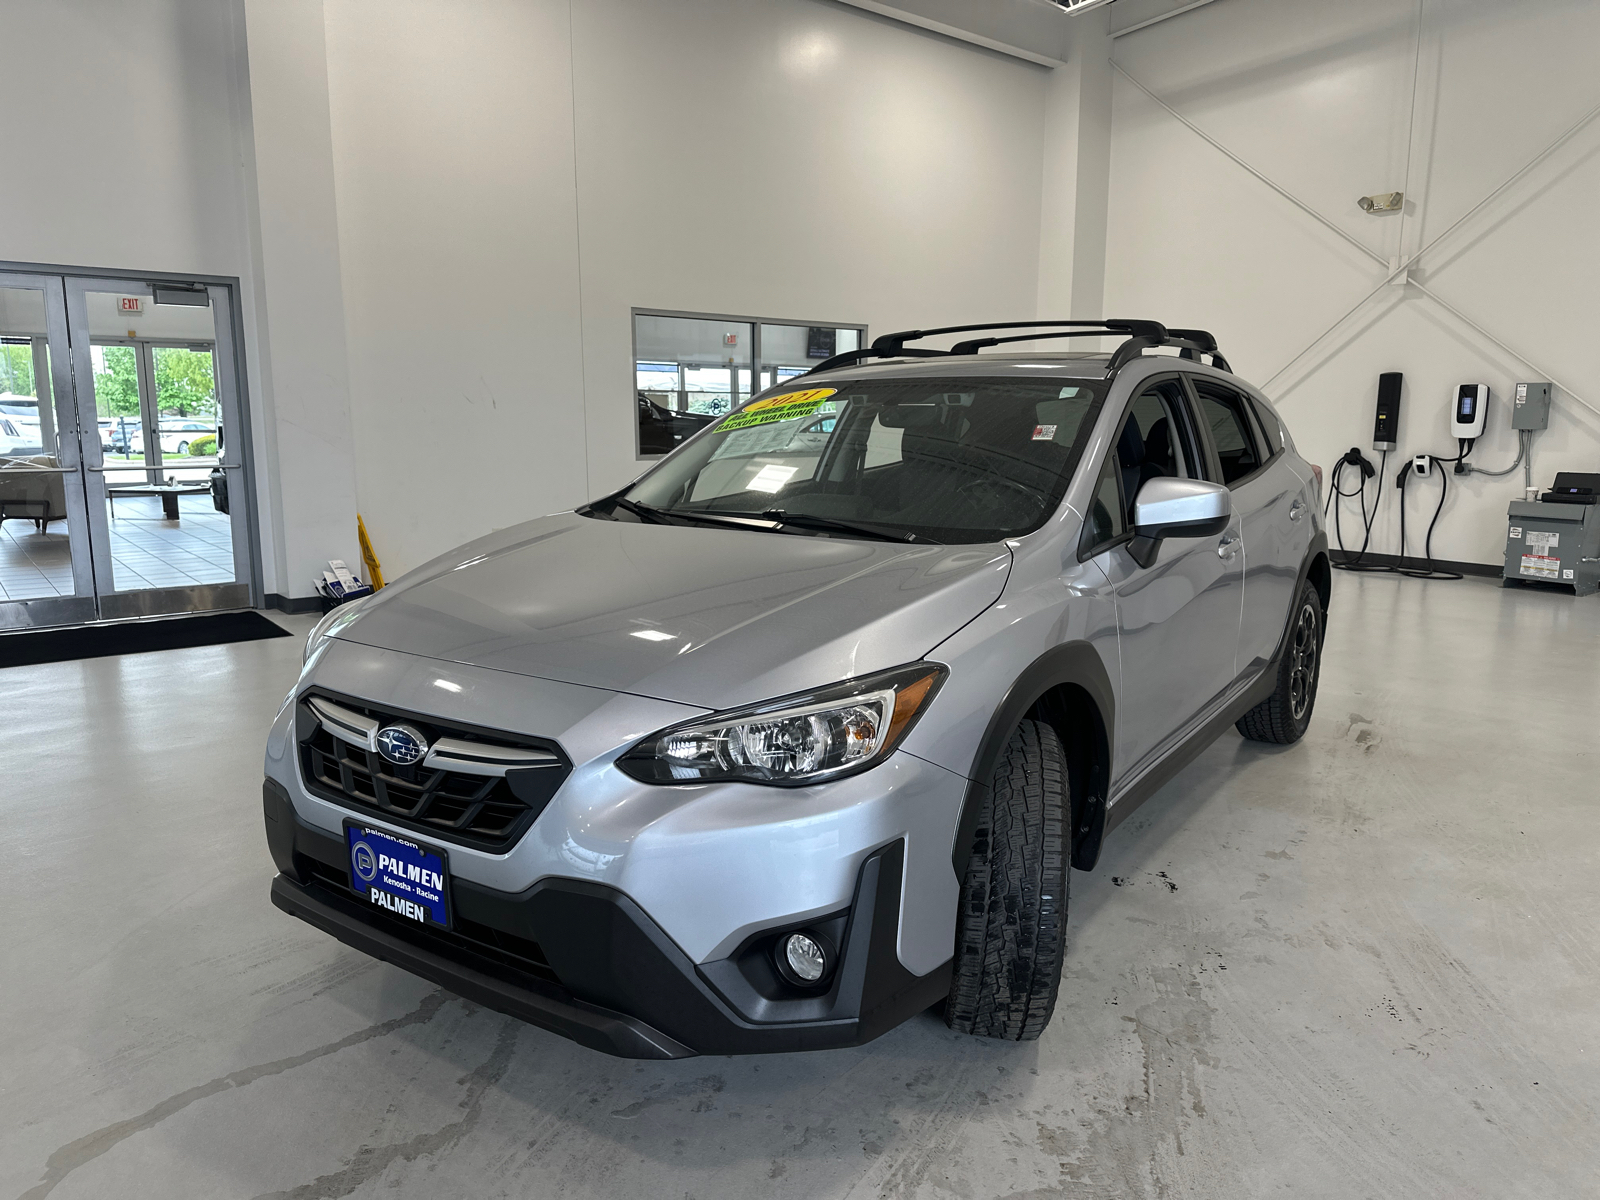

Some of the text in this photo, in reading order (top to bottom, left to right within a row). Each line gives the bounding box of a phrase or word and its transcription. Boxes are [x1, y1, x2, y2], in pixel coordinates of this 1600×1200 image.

[122, 298, 138, 310] EXIT
[756, 390, 822, 409] 2021
[715, 408, 815, 431] BACKUP WARNING
[728, 400, 820, 422] ALL WHEEL DRIVE
[365, 828, 418, 849] palmen.com
[378, 854, 443, 891] PALMEN
[383, 875, 411, 892] Kenosha
[416, 887, 439, 903] Racine
[371, 887, 424, 923] PALMEN
